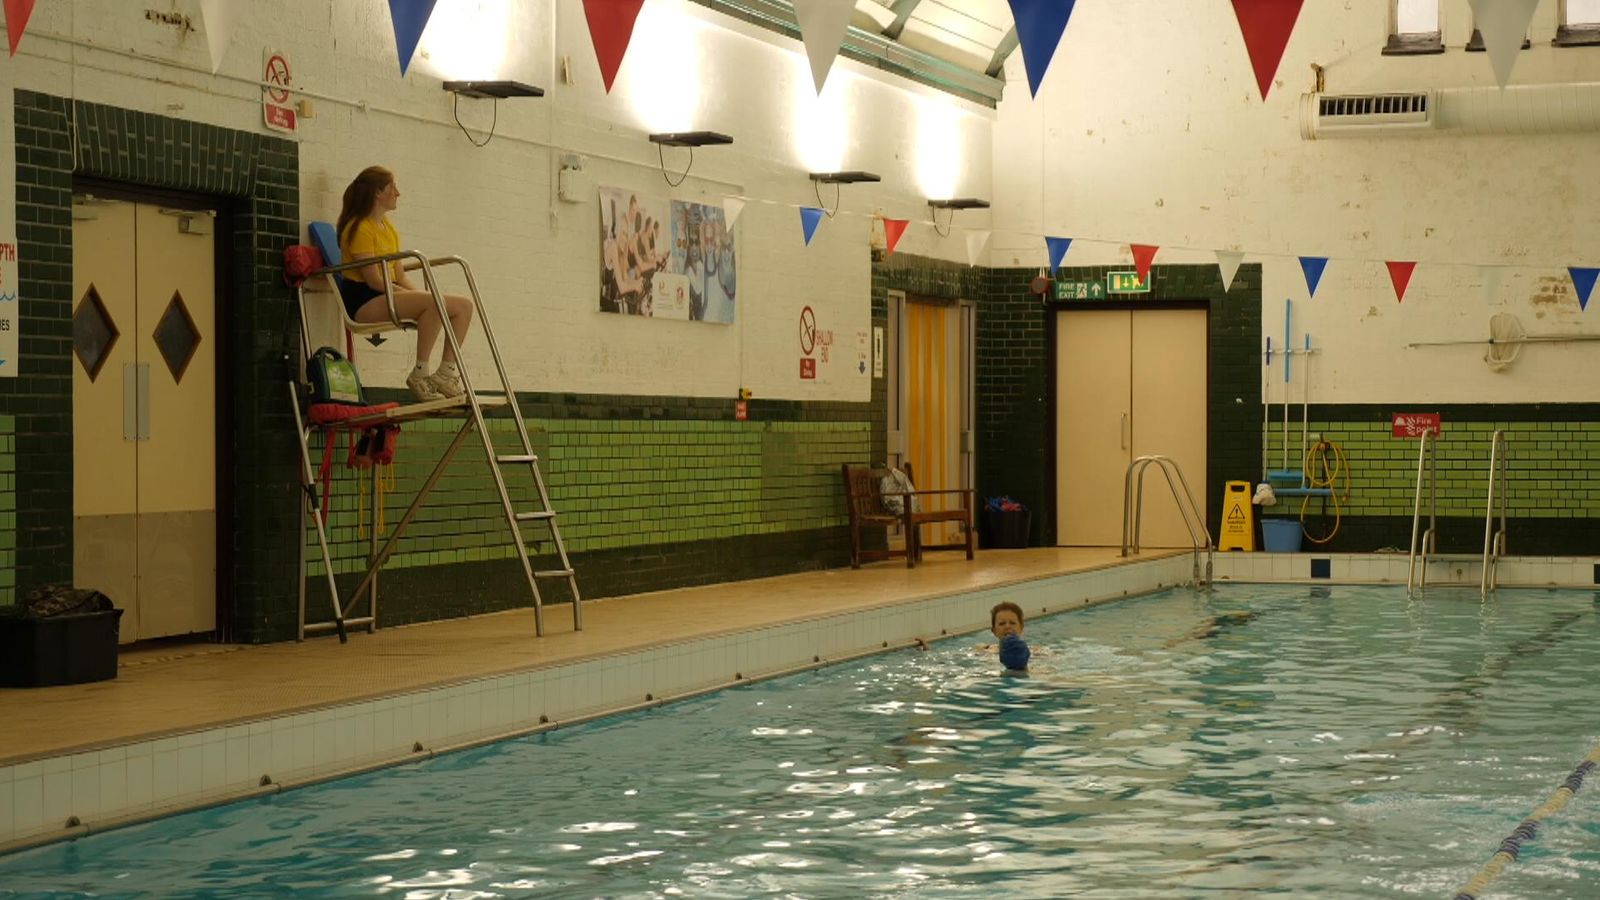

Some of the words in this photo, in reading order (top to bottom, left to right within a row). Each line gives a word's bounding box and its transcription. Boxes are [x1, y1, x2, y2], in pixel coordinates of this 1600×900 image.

[1058, 282, 1075, 291] FIRE
[1058, 291, 1075, 299] EXIT
[1416, 416, 1432, 425] Fire
[1416, 425, 1437, 434] pot
